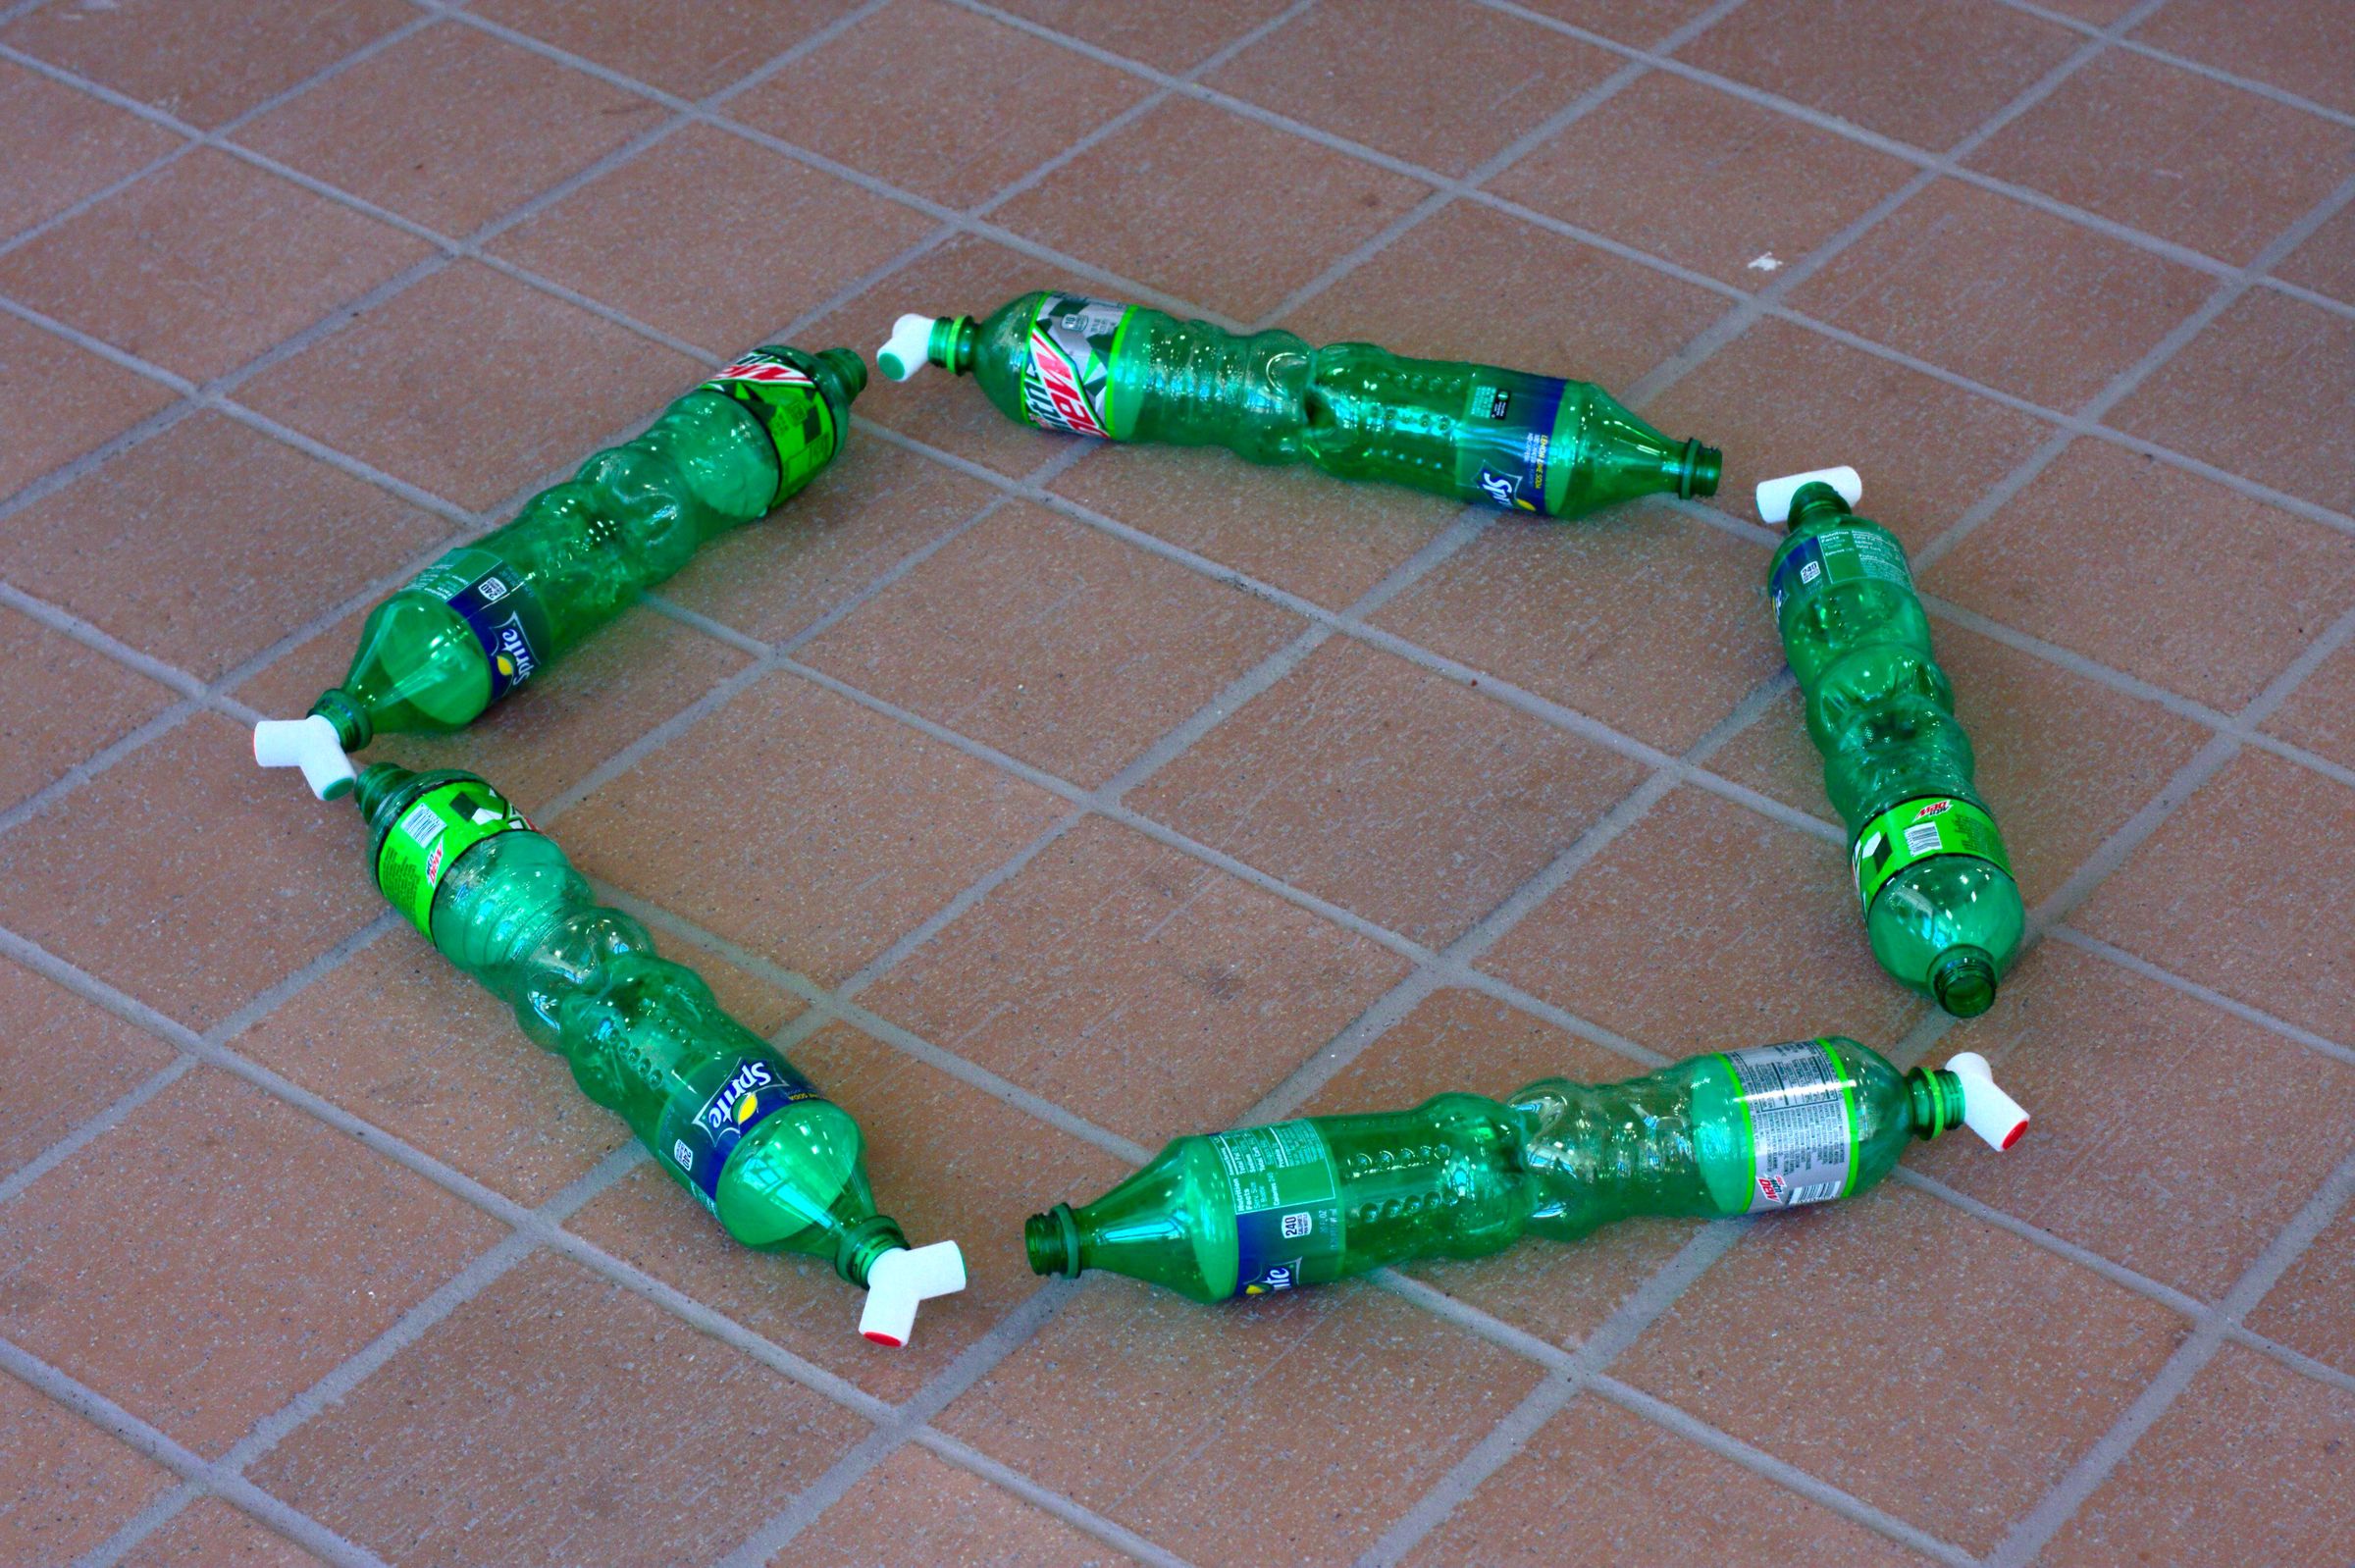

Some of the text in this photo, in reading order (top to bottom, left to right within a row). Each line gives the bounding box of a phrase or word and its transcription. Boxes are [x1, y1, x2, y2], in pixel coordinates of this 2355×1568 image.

[1802, 562, 1817, 577] 240
[482, 584, 498, 600] 240
[501, 628, 535, 685] Sprite
[707, 1062, 771, 1128] Sprite
[1285, 1217, 1298, 1236] 240
